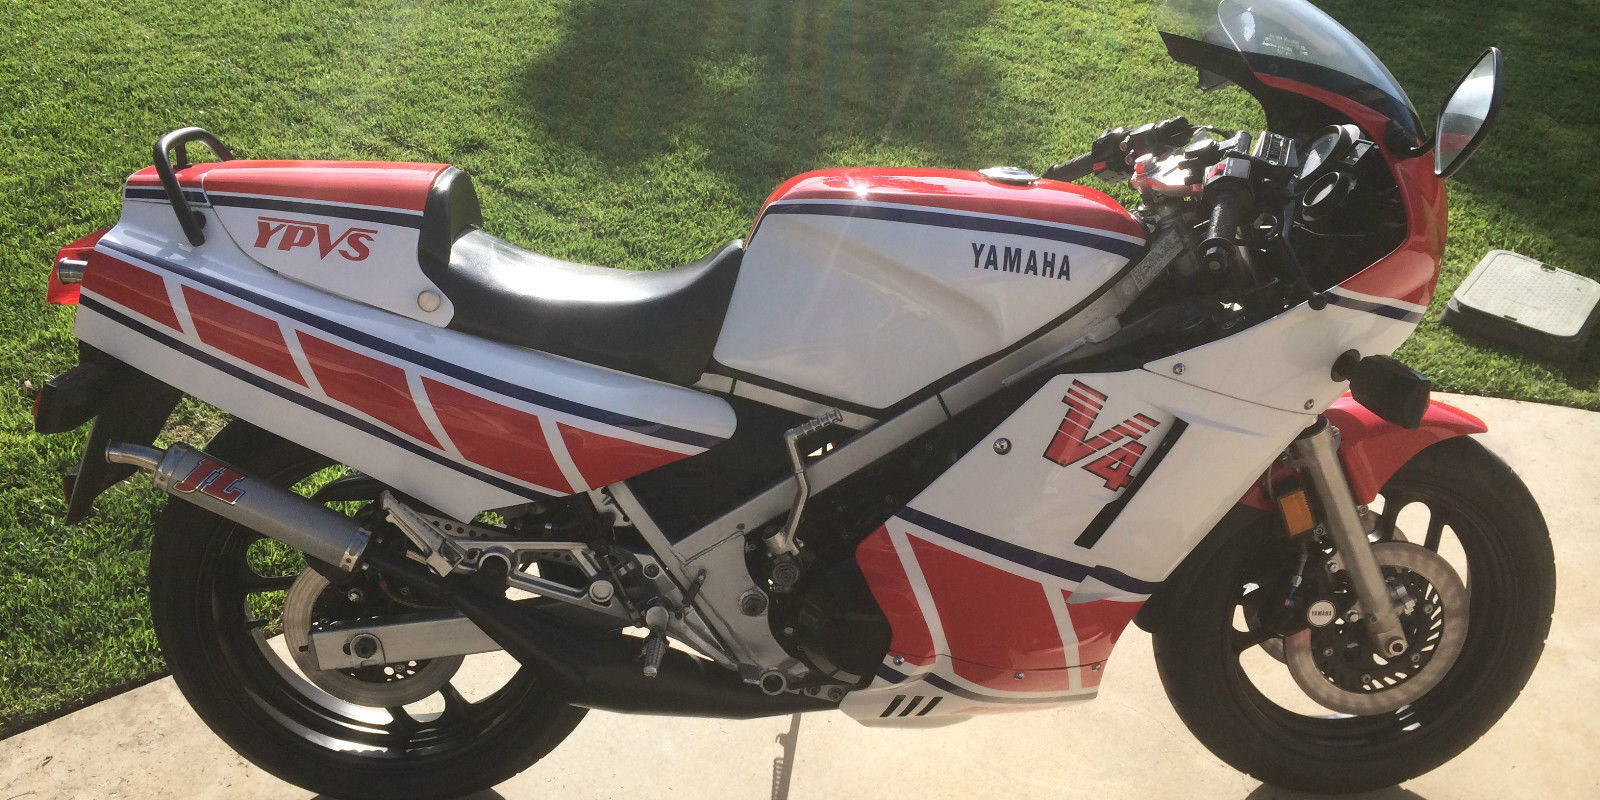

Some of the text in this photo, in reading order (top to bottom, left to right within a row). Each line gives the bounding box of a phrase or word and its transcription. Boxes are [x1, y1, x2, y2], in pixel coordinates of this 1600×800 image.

[254, 216, 378, 261] YPVS
[972, 242, 1071, 281] YAMAHA
[1042, 378, 1161, 492] V4
[173, 458, 246, 505] JL
